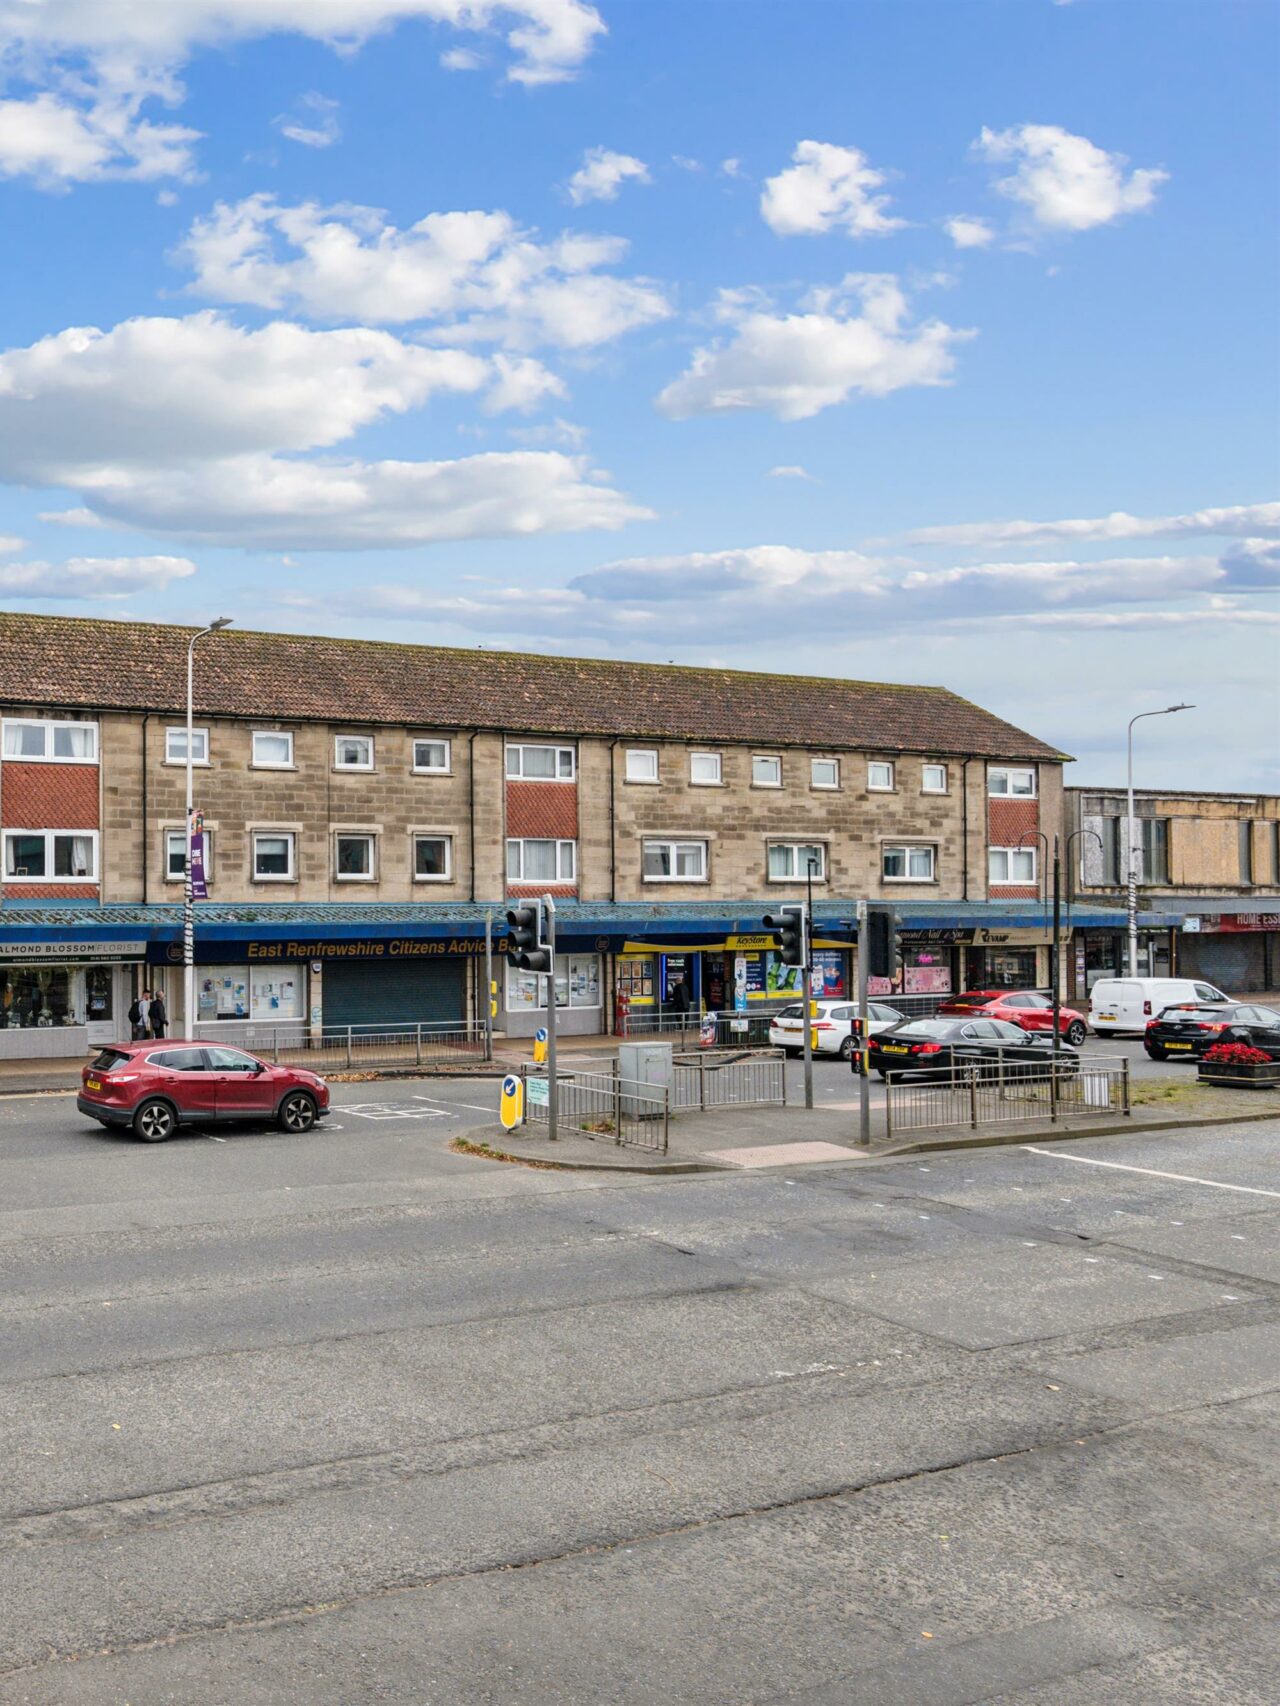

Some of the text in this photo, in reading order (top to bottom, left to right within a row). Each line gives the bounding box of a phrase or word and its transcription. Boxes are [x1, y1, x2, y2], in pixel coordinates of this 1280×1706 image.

[1237, 913, 1260, 924] HOME
[736, 936, 767, 945] KeyStore
[97, 943, 138, 951] FLORIST
[248, 942, 282, 957] East
[286, 941, 384, 957] Renfrewshire
[389, 940, 445, 955] Citizens
